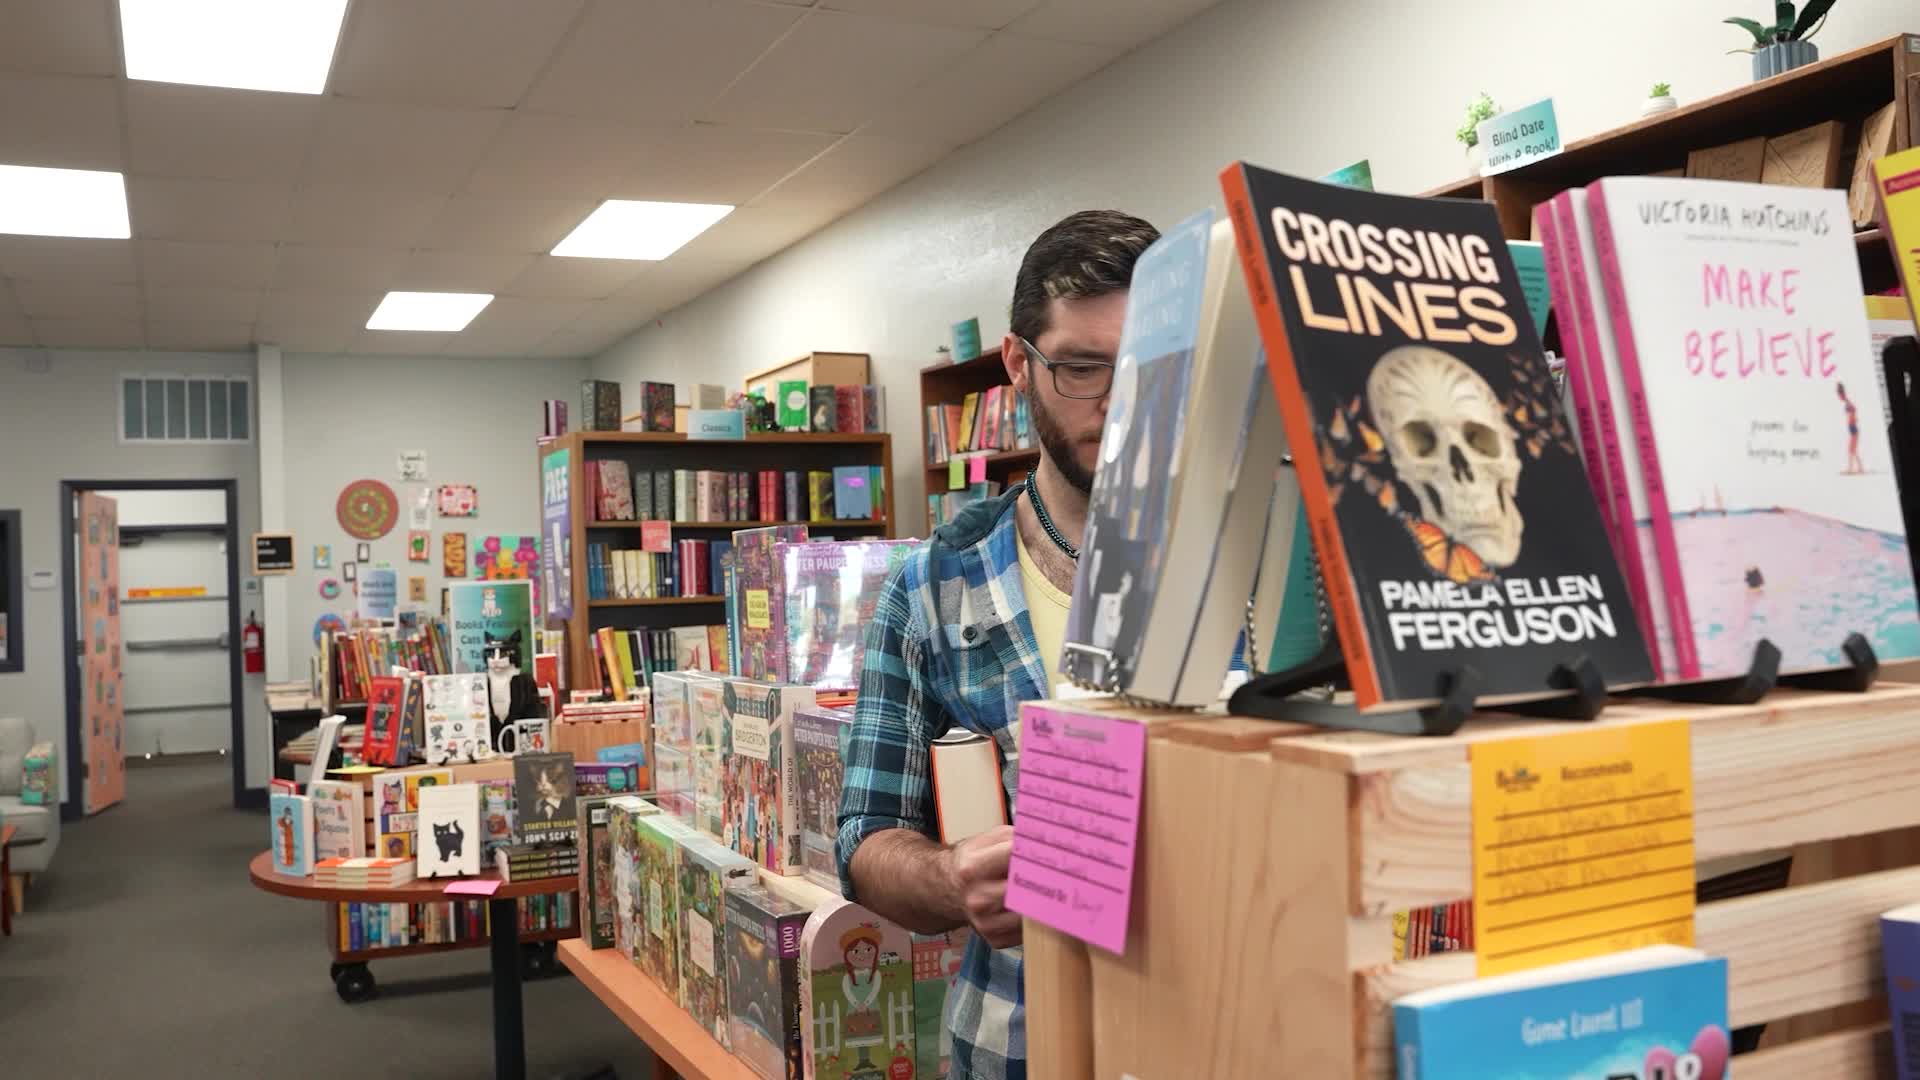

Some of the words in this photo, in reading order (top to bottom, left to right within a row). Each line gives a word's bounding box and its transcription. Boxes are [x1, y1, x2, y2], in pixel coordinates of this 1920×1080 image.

[1492, 128, 1518, 147] Blind
[1521, 120, 1545, 137] Date
[1638, 200, 1731, 226] VICTORIA
[1742, 204, 1831, 236] HUTCHINS
[1271, 207, 1500, 284] CROSSING
[1288, 265, 1518, 346] LINES
[1702, 262, 1801, 315] MAKE
[1684, 328, 1837, 379] BELIEVE
[702, 423, 732, 433] Classics
[544, 466, 568, 505] FREE
[1379, 579, 1504, 610] PAMELA
[1504, 574, 1605, 606] ELLEN
[456, 620, 484, 630] Books
[461, 635, 481, 645] Cats
[1388, 603, 1617, 651] FERGUSON
[525, 833, 546, 844] JOHN
[783, 926, 794, 953] 1000
